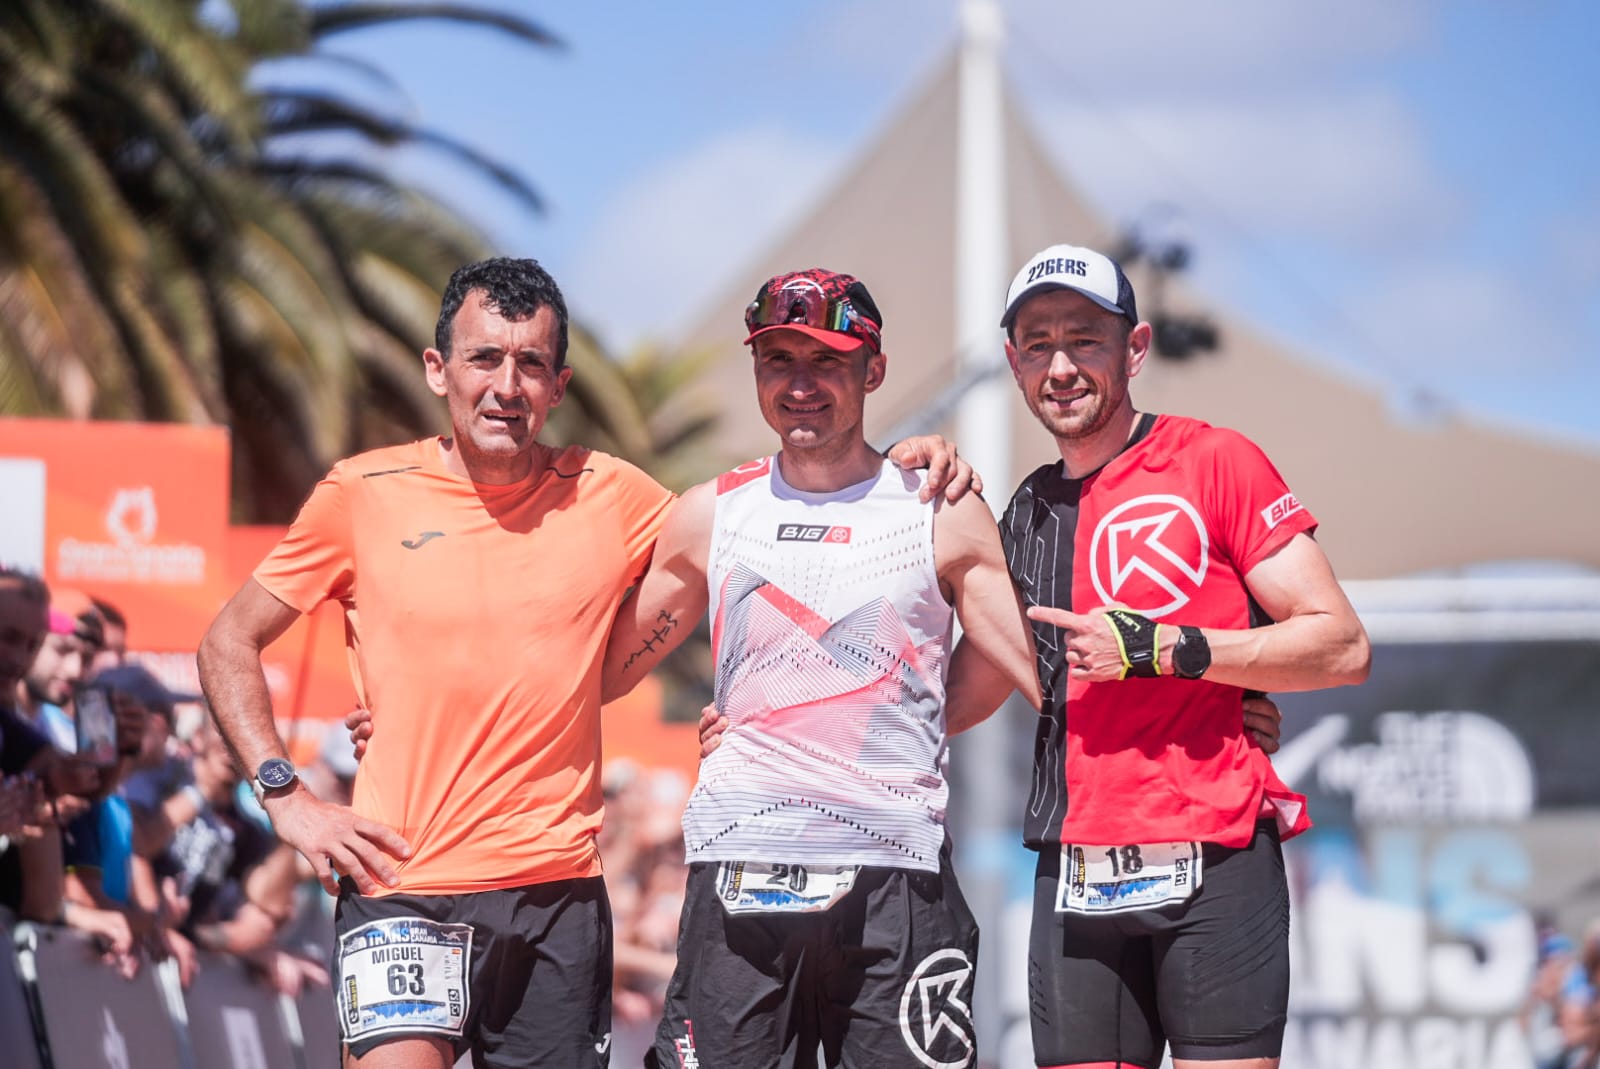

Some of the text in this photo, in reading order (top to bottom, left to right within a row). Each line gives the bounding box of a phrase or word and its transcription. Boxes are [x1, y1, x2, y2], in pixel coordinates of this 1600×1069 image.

[1027, 258, 1087, 285] 226ERS
[780, 526, 825, 540] BIG
[1105, 844, 1144, 877] 18
[766, 863, 808, 892] 20
[371, 946, 424, 965] MIGUEL
[386, 963, 426, 996] 63
